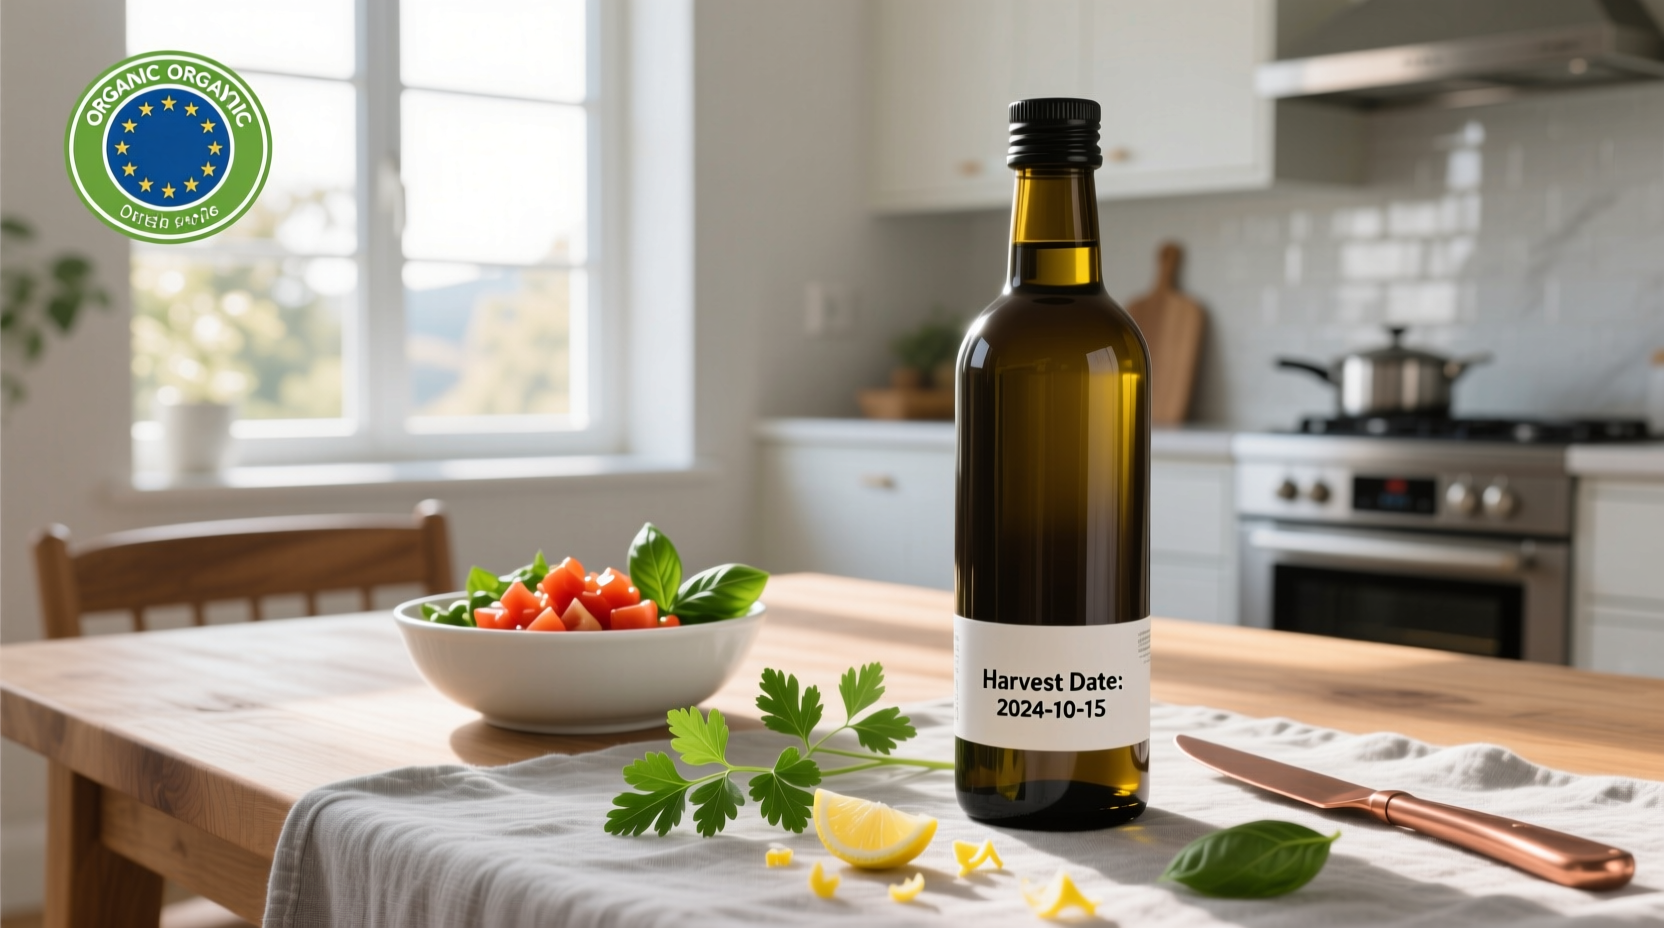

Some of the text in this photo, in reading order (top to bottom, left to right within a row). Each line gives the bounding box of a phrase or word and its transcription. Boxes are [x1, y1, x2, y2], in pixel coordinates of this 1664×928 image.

[983, 668, 1123, 692] Harvest Date:
[996, 698, 1106, 719] 2024-10-15
